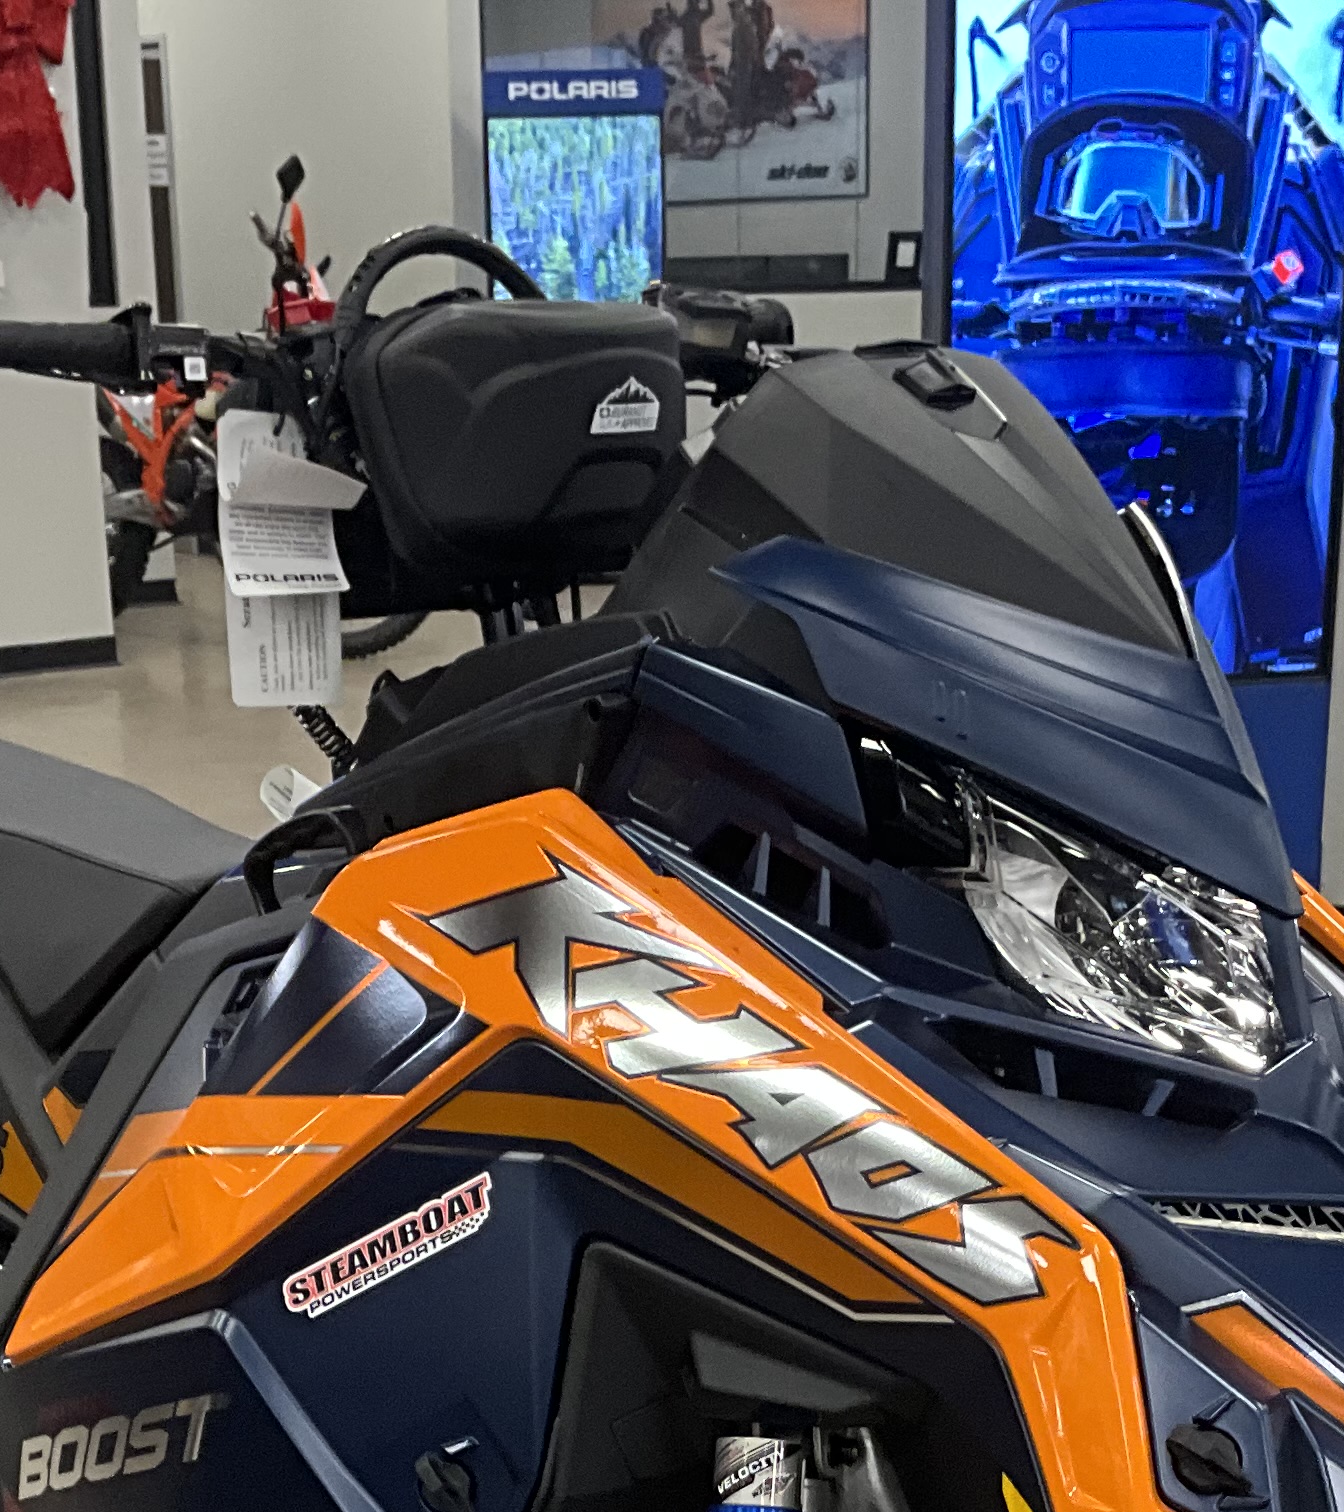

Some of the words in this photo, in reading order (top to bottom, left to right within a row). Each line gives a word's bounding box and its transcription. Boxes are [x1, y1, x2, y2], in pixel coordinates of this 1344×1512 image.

[507, 79, 639, 101] POLARIS
[235, 573, 339, 583] POLARIS
[413, 845, 1083, 1306] KHAOS
[289, 1179, 485, 1305] STEAMBOAT
[309, 1229, 455, 1314] POWERSPORTS
[18, 1393, 231, 1500] BOOST
